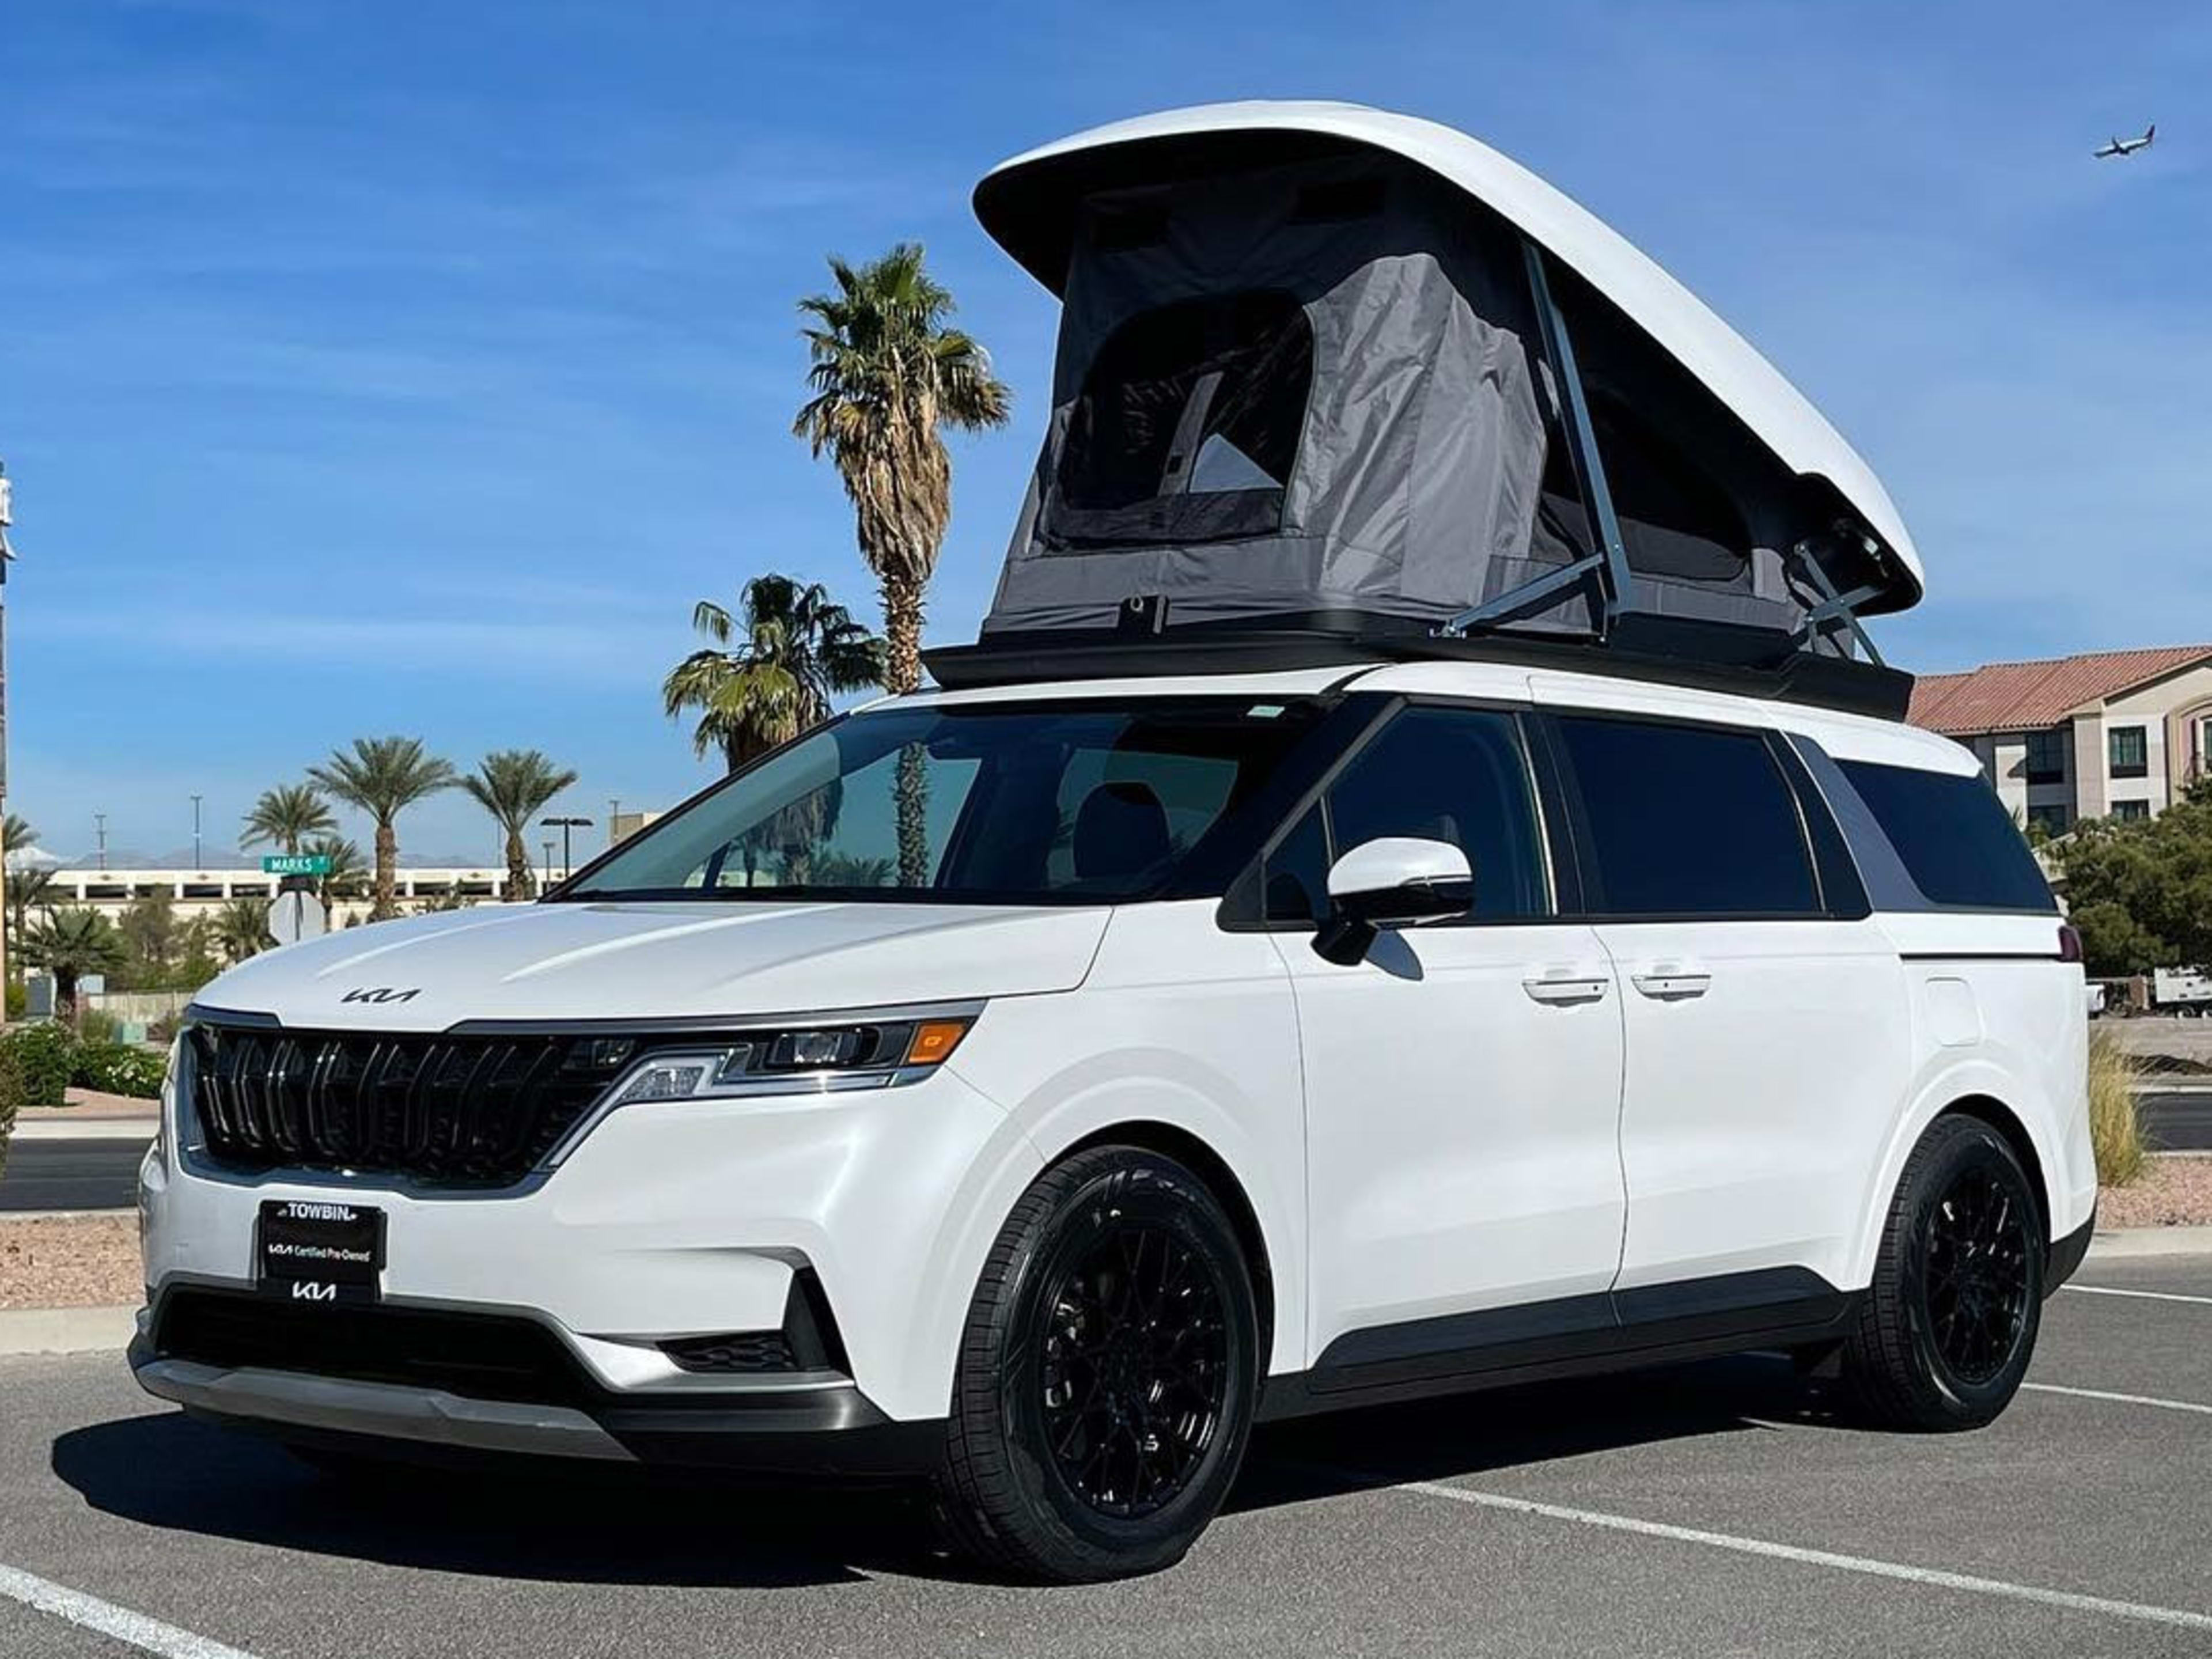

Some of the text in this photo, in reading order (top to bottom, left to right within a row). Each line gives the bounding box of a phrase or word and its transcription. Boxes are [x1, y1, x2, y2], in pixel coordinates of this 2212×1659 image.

[271, 858, 312, 872] MARKS
[288, 1203, 351, 1221] TOWBIN
[294, 1245, 326, 1257] Certified
[327, 1247, 370, 1262] Pre-Owned
